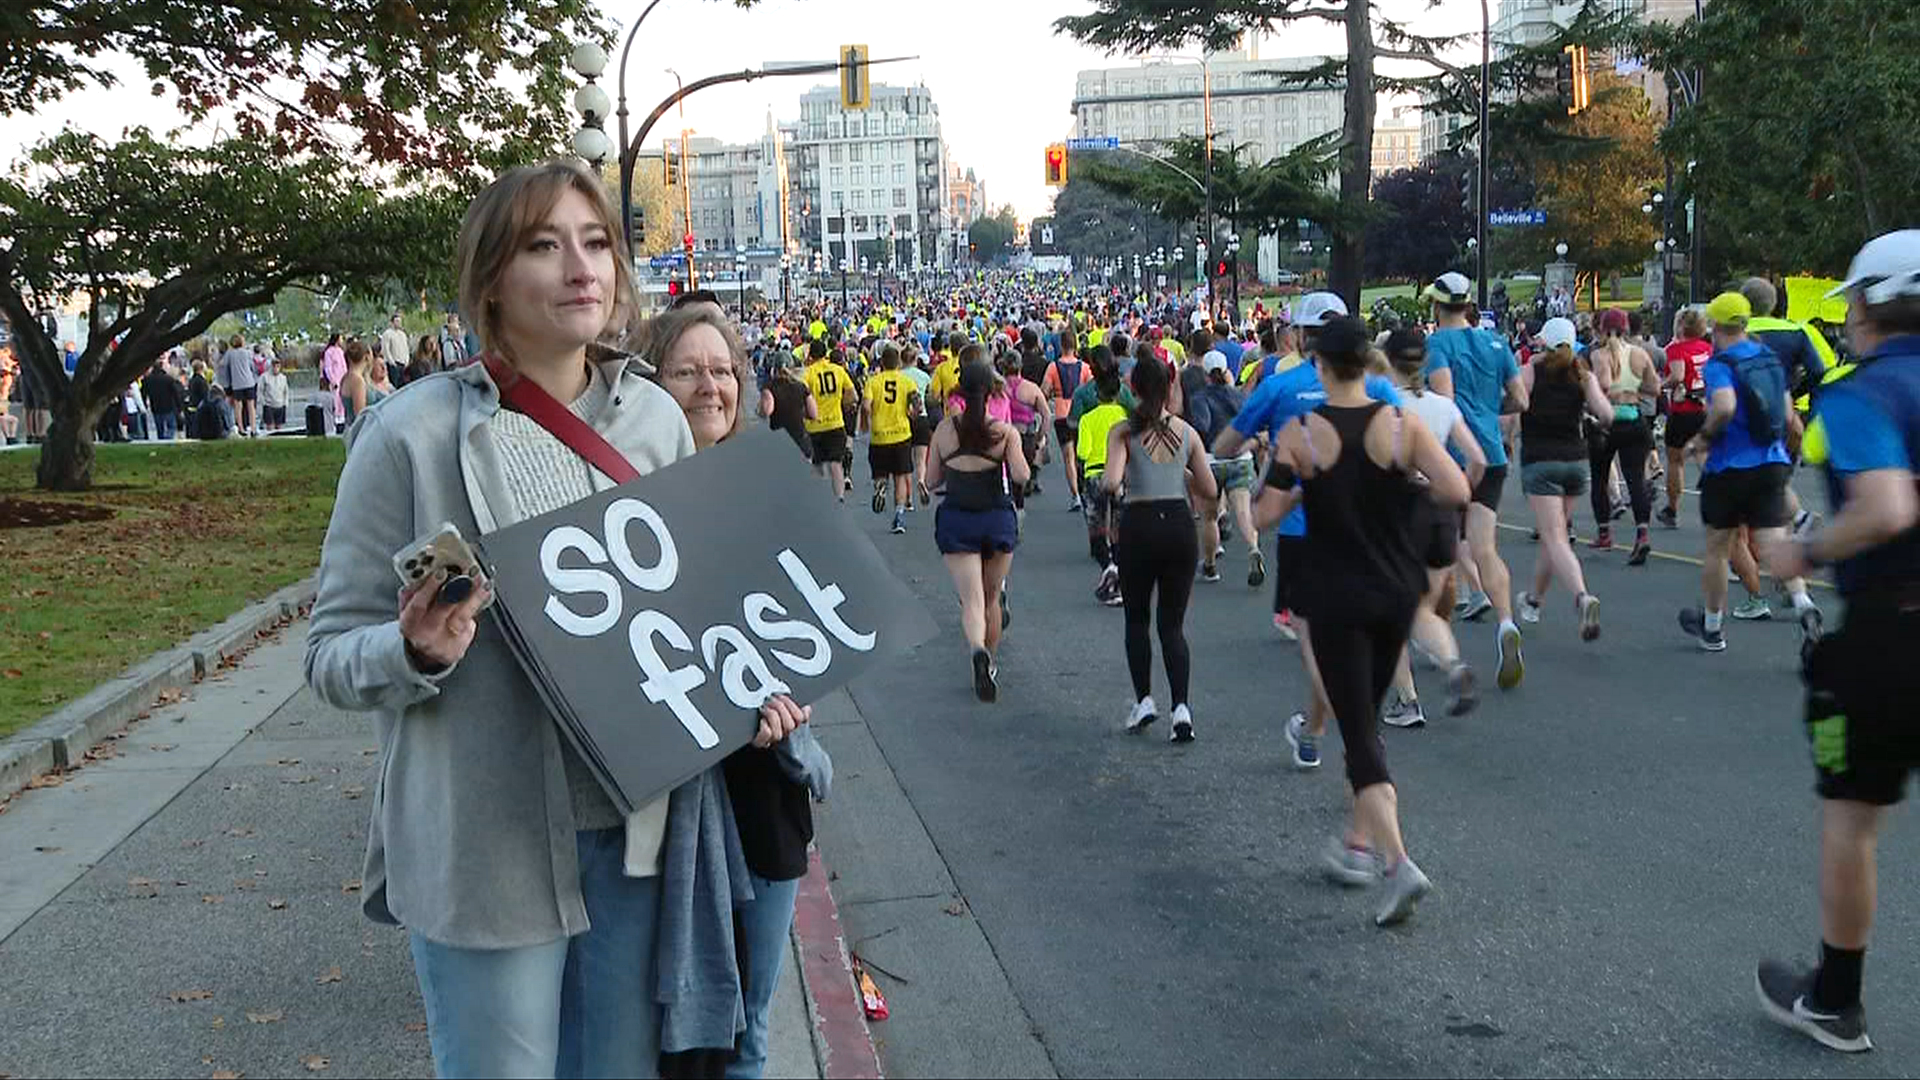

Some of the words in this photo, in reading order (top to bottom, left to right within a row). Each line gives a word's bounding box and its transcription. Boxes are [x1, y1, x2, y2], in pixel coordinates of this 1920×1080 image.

[1490, 211, 1532, 224] Belleville
[817, 371, 837, 396] 10
[884, 380, 897, 404] 5
[628, 547, 877, 750] fast
